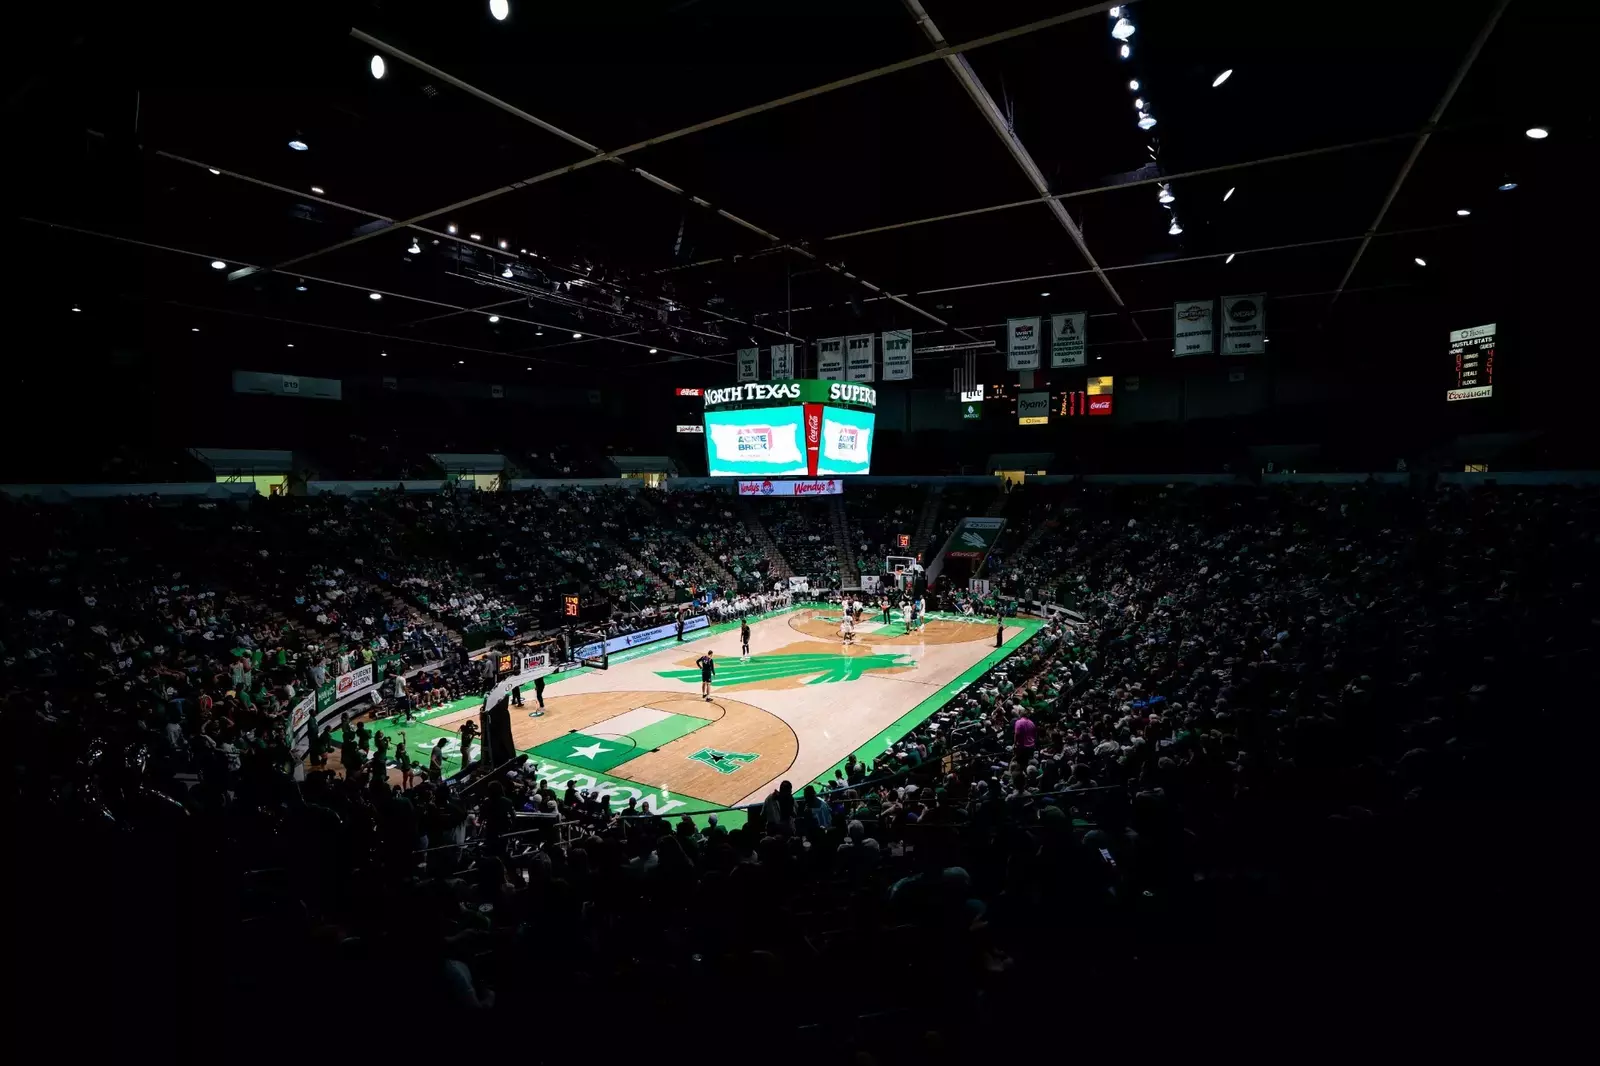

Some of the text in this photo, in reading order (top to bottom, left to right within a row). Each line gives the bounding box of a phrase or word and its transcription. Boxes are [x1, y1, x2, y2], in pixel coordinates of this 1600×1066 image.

[821, 342, 840, 352] NIT
[850, 339, 869, 349] NIT
[886, 339, 909, 350] NIT
[1452, 337, 1492, 348] HUSTLE STATS
[1479, 342, 1495, 350] GUEST
[705, 388, 742, 407] NORTH
[743, 384, 801, 401] TEXAS
[738, 435, 767, 443] ACME
[838, 434, 855, 443] ACME
[738, 443, 768, 451] BRICK
[794, 480, 826, 496] Wendy's
[566, 603, 577, 616] 30
[353, 669, 371, 681] STUDENT
[353, 676, 371, 688] SECTION
